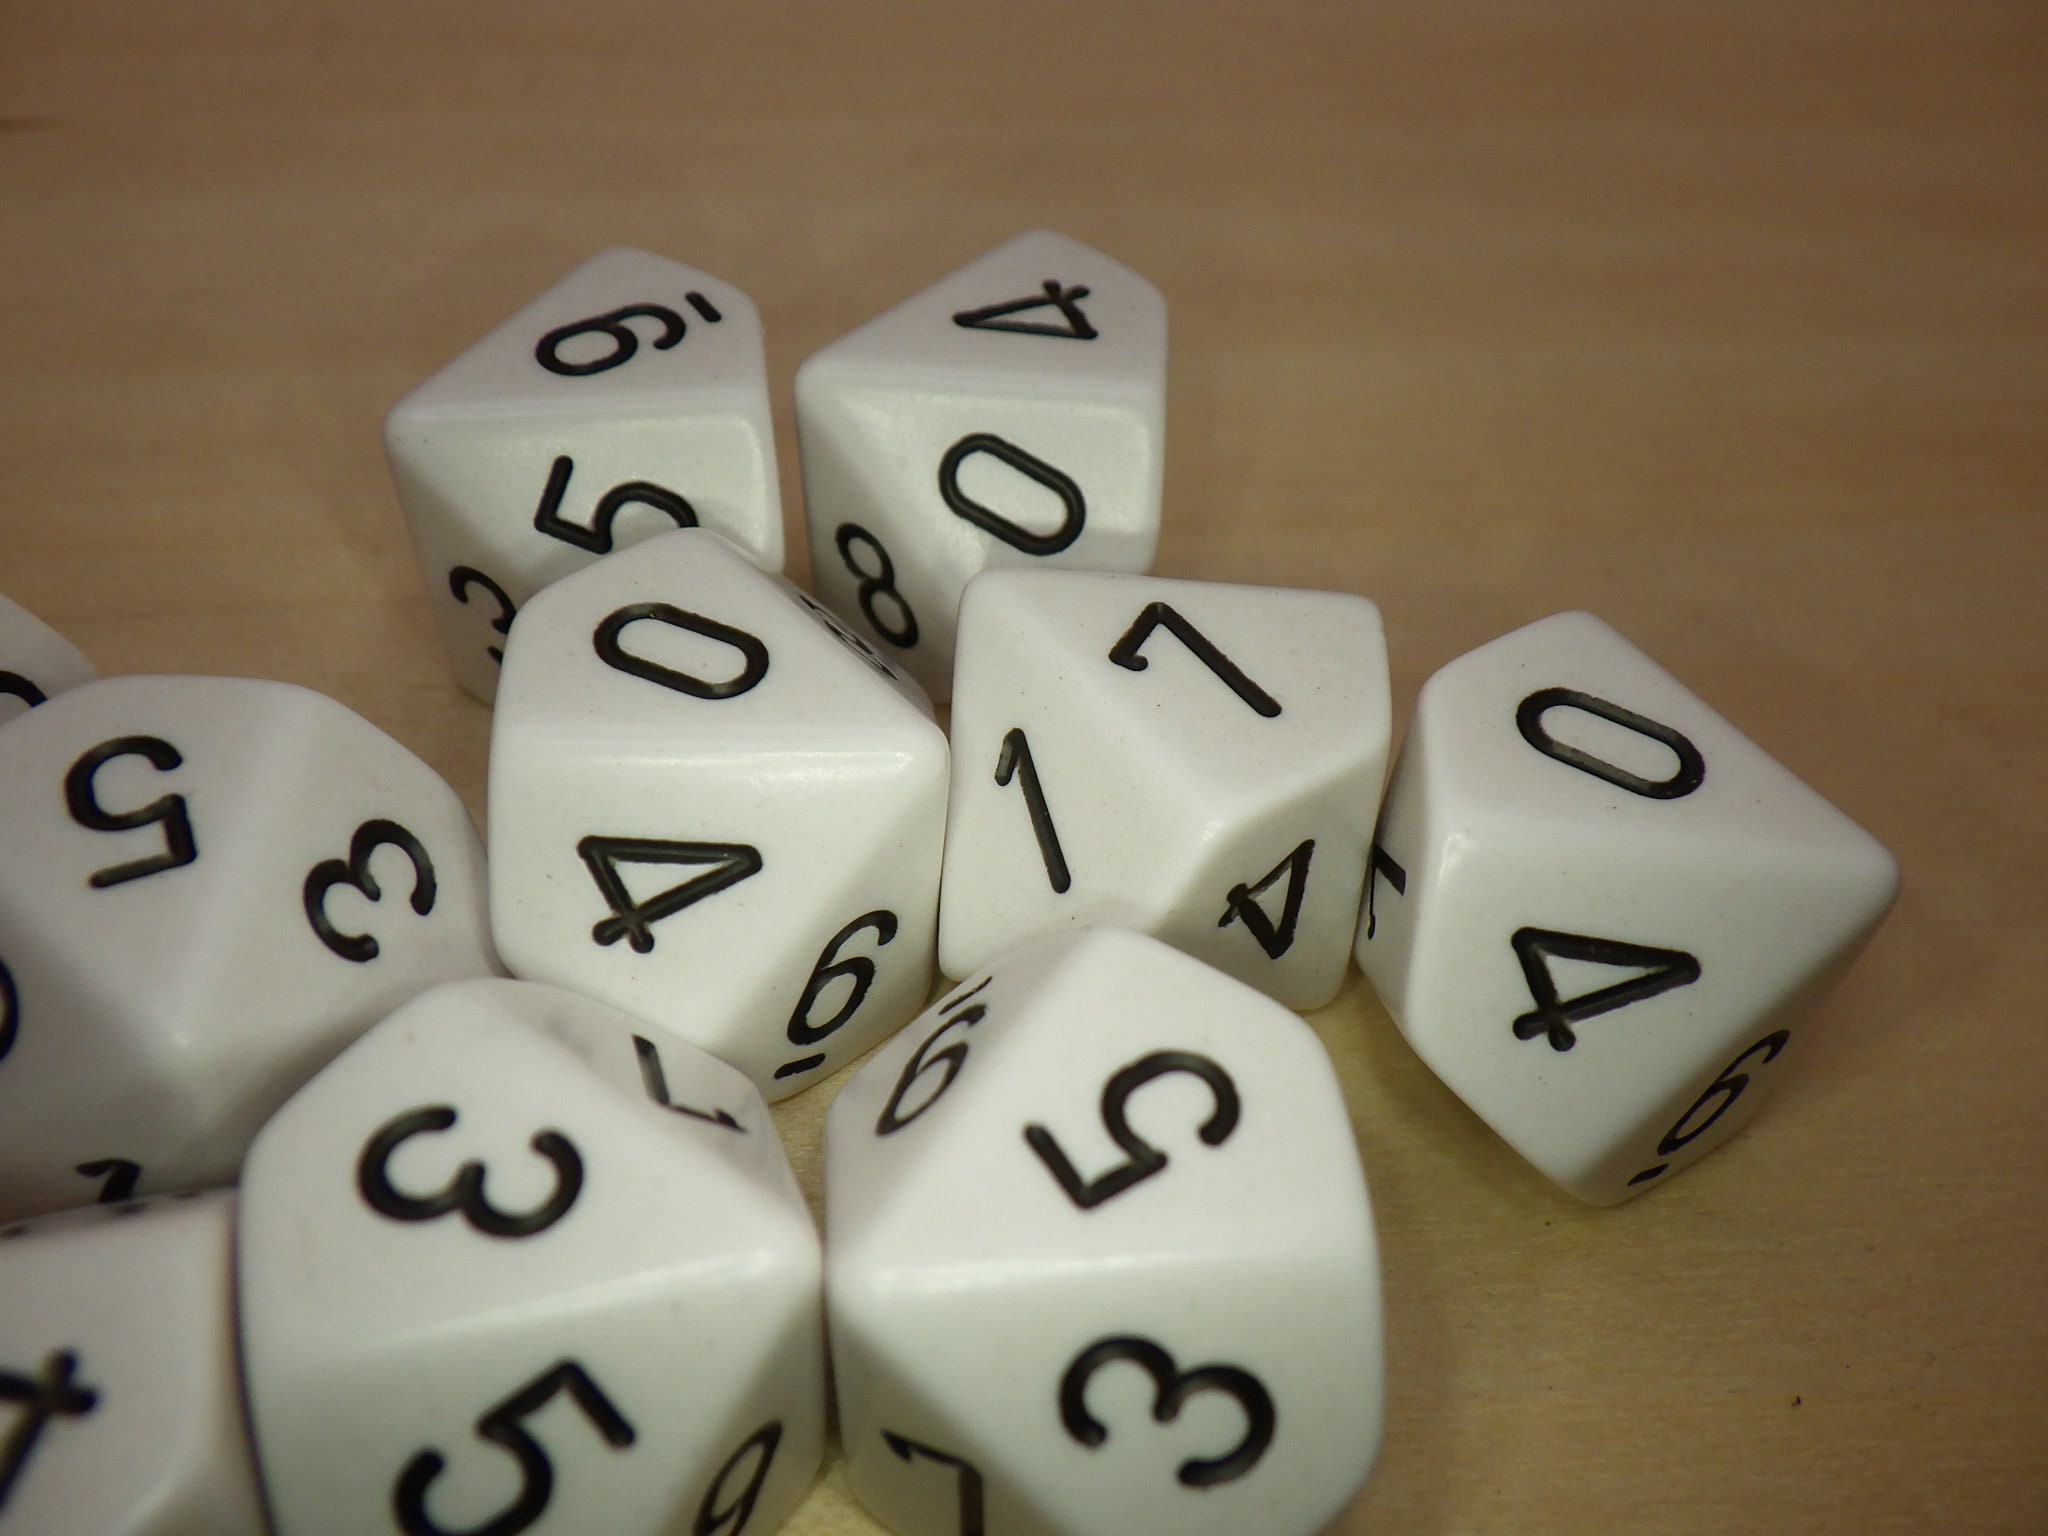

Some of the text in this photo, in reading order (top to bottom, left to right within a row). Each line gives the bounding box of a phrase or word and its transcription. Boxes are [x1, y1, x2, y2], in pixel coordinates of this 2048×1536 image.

[952, 280, 1099, 341] 4
[533, 455, 700, 556] 5
[938, 433, 1086, 557] 0
[834, 522, 920, 650] 8
[593, 602, 770, 701] 0
[1515, 687, 1706, 801] 0
[63, 735, 199, 890] 5
[994, 727, 1072, 894] 1
[303, 818, 438, 963] 3
[576, 835, 763, 954] 4
[1217, 838, 1316, 961] 4
[1510, 926, 1702, 1052] 4
[357, 1106, 585, 1240] 3
[1024, 1051, 1241, 1210] 5
[389, 1360, 637, 1536] 5
[1057, 1334, 1277, 1490] 3
[878, 1426, 993, 1536] 7
